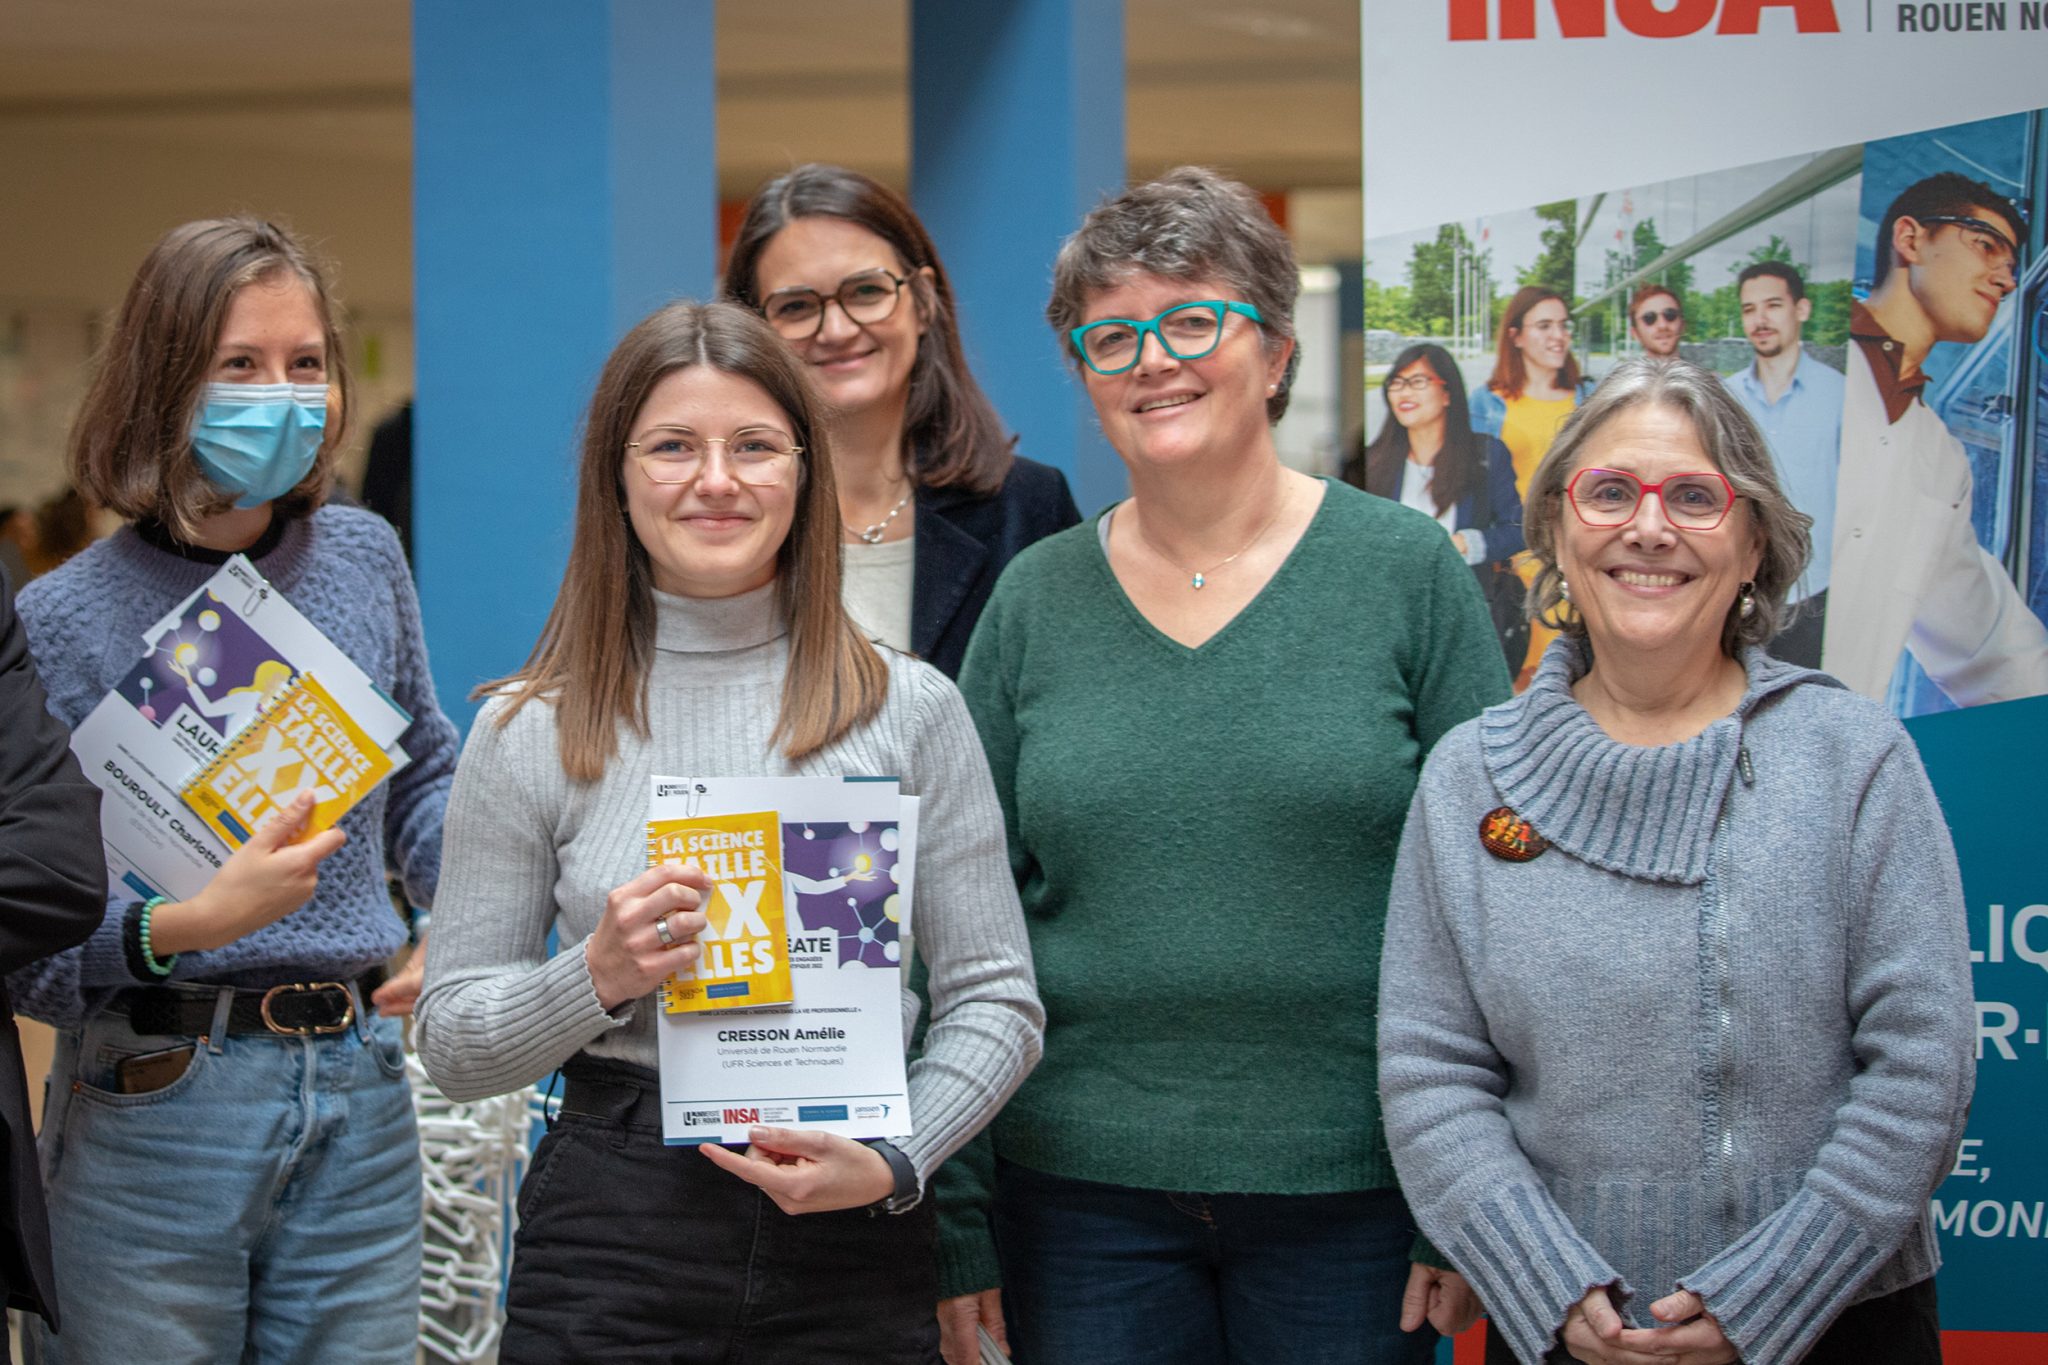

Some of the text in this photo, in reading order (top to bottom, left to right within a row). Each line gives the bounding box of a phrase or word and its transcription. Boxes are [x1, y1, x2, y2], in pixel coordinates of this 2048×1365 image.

[1898, 2, 2048, 32] ROUEN N
[294, 692, 374, 774] LA SCIENCE
[277, 705, 361, 794] TAILLE
[103, 760, 170, 820] BOUROULT
[168, 817, 224, 870] Charlotte
[661, 830, 765, 855] LA SCIENCE
[663, 850, 766, 881] ILLE
[676, 940, 775, 982] LLES
[717, 1027, 845, 1042] CRESSON Amélie
[717, 1045, 847, 1055] Université de Rouen Normandie
[722, 1057, 844, 1068] (UFR Sciences et Techniques)
[723, 1108, 760, 1124] INSA
[1931, 1199, 2048, 1238] MON
